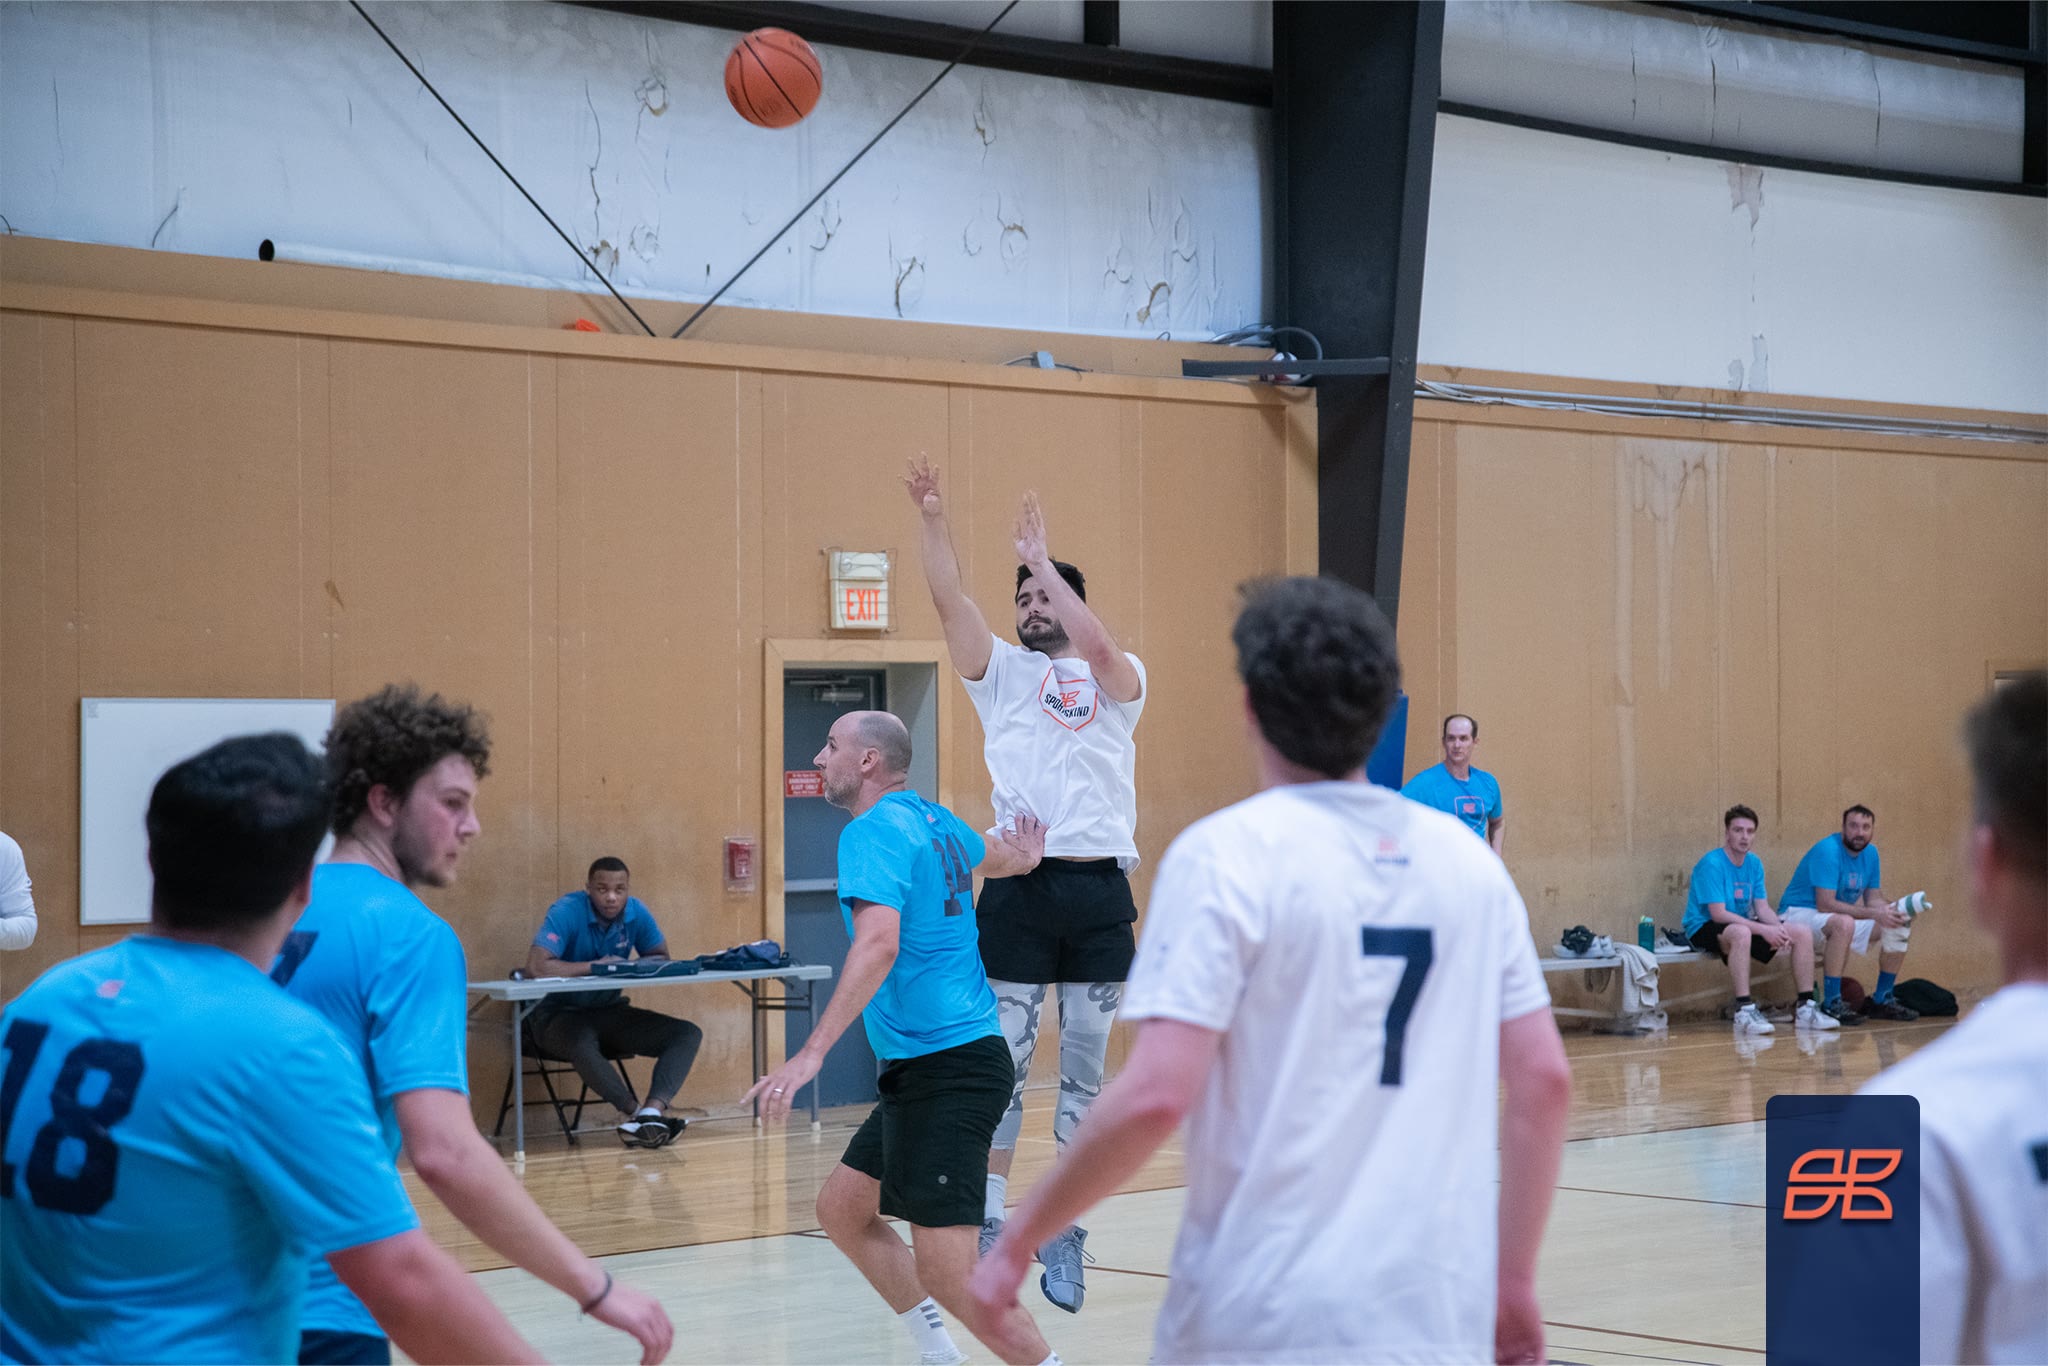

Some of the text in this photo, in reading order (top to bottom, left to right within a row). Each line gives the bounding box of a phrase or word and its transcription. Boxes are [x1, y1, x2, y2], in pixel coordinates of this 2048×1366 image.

[846, 588, 881, 621] EXIT
[1044, 693, 1090, 718] SPORSKIND
[1361, 927, 1434, 1086] 7
[0, 1019, 146, 1216] 18
